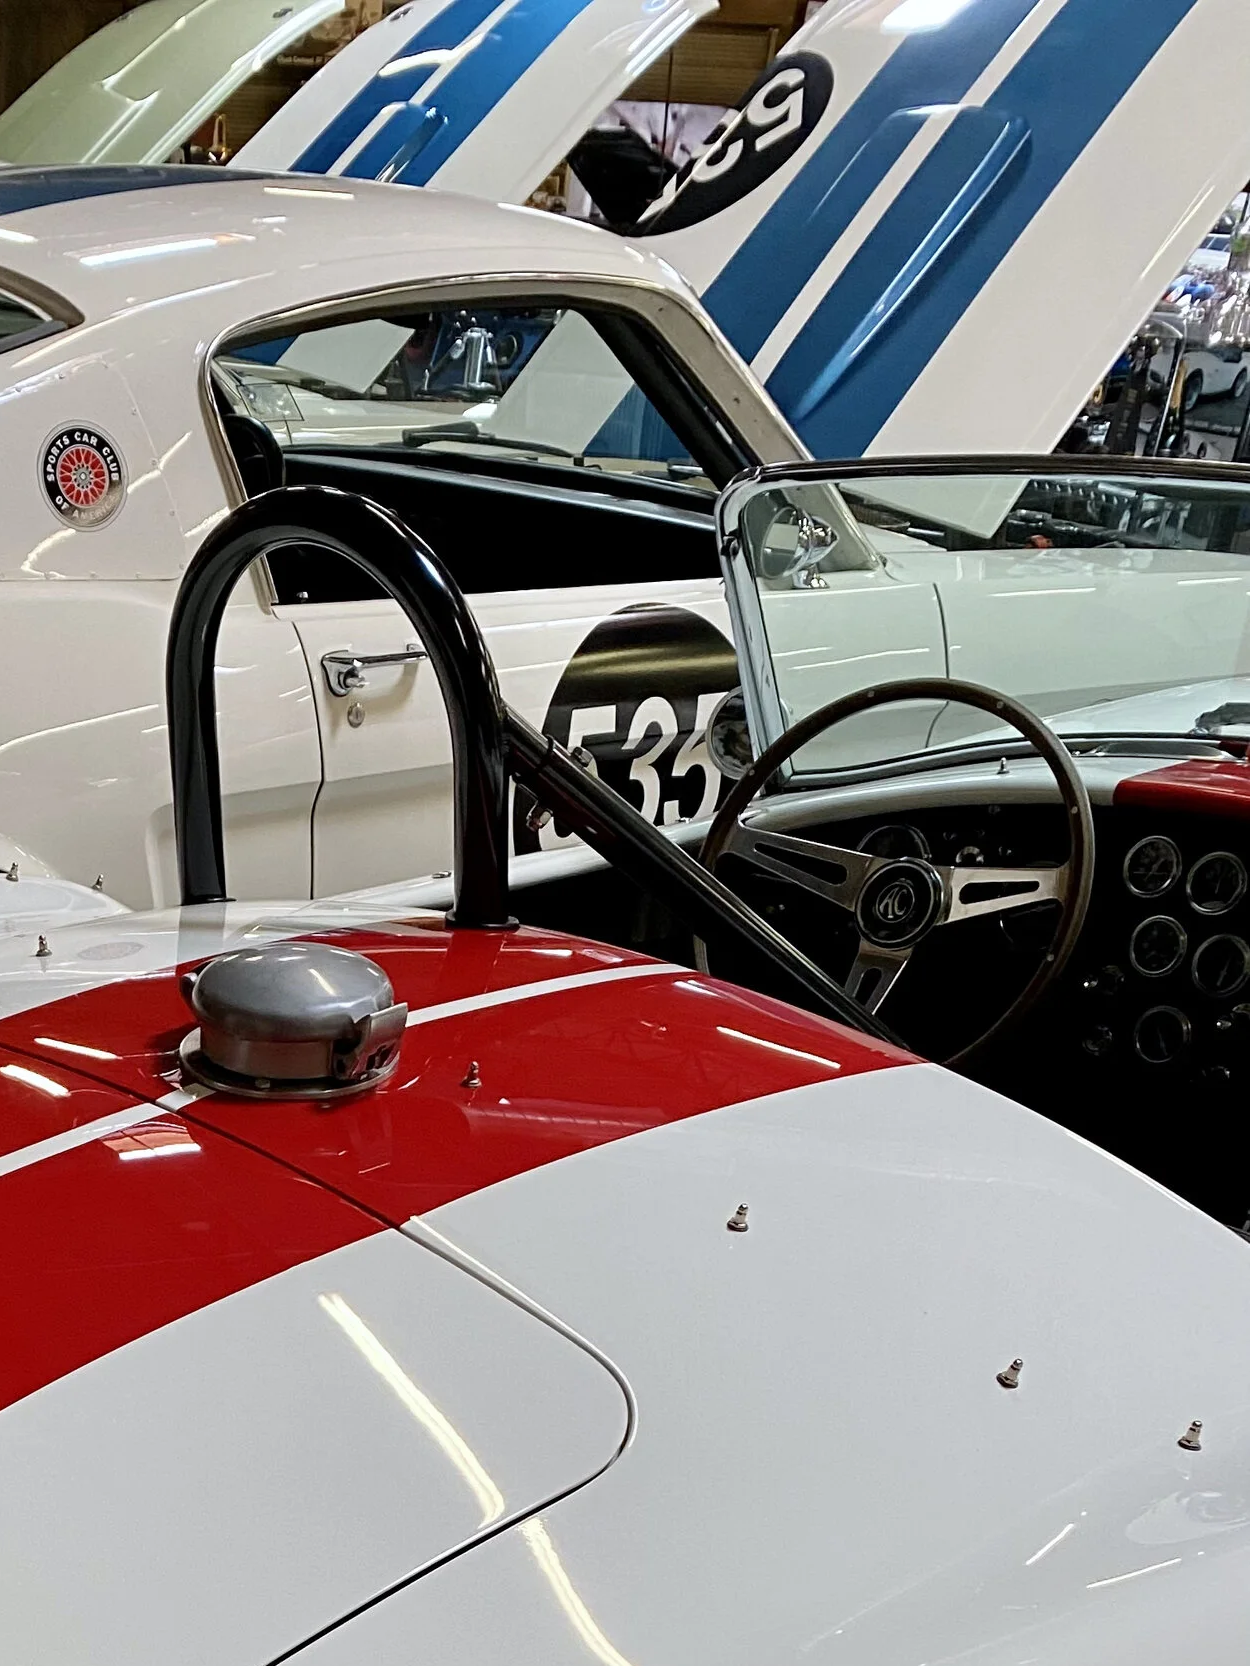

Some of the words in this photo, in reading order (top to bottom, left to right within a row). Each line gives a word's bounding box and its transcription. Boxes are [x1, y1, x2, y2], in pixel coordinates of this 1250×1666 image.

[46, 434, 71, 482] SPORTS
[73, 431, 99, 447] CAR
[101, 446, 121, 481] CLUB
[55, 495, 71, 511] OF
[72, 492, 121, 521] AMERICA
[878, 886, 909, 919] AC
